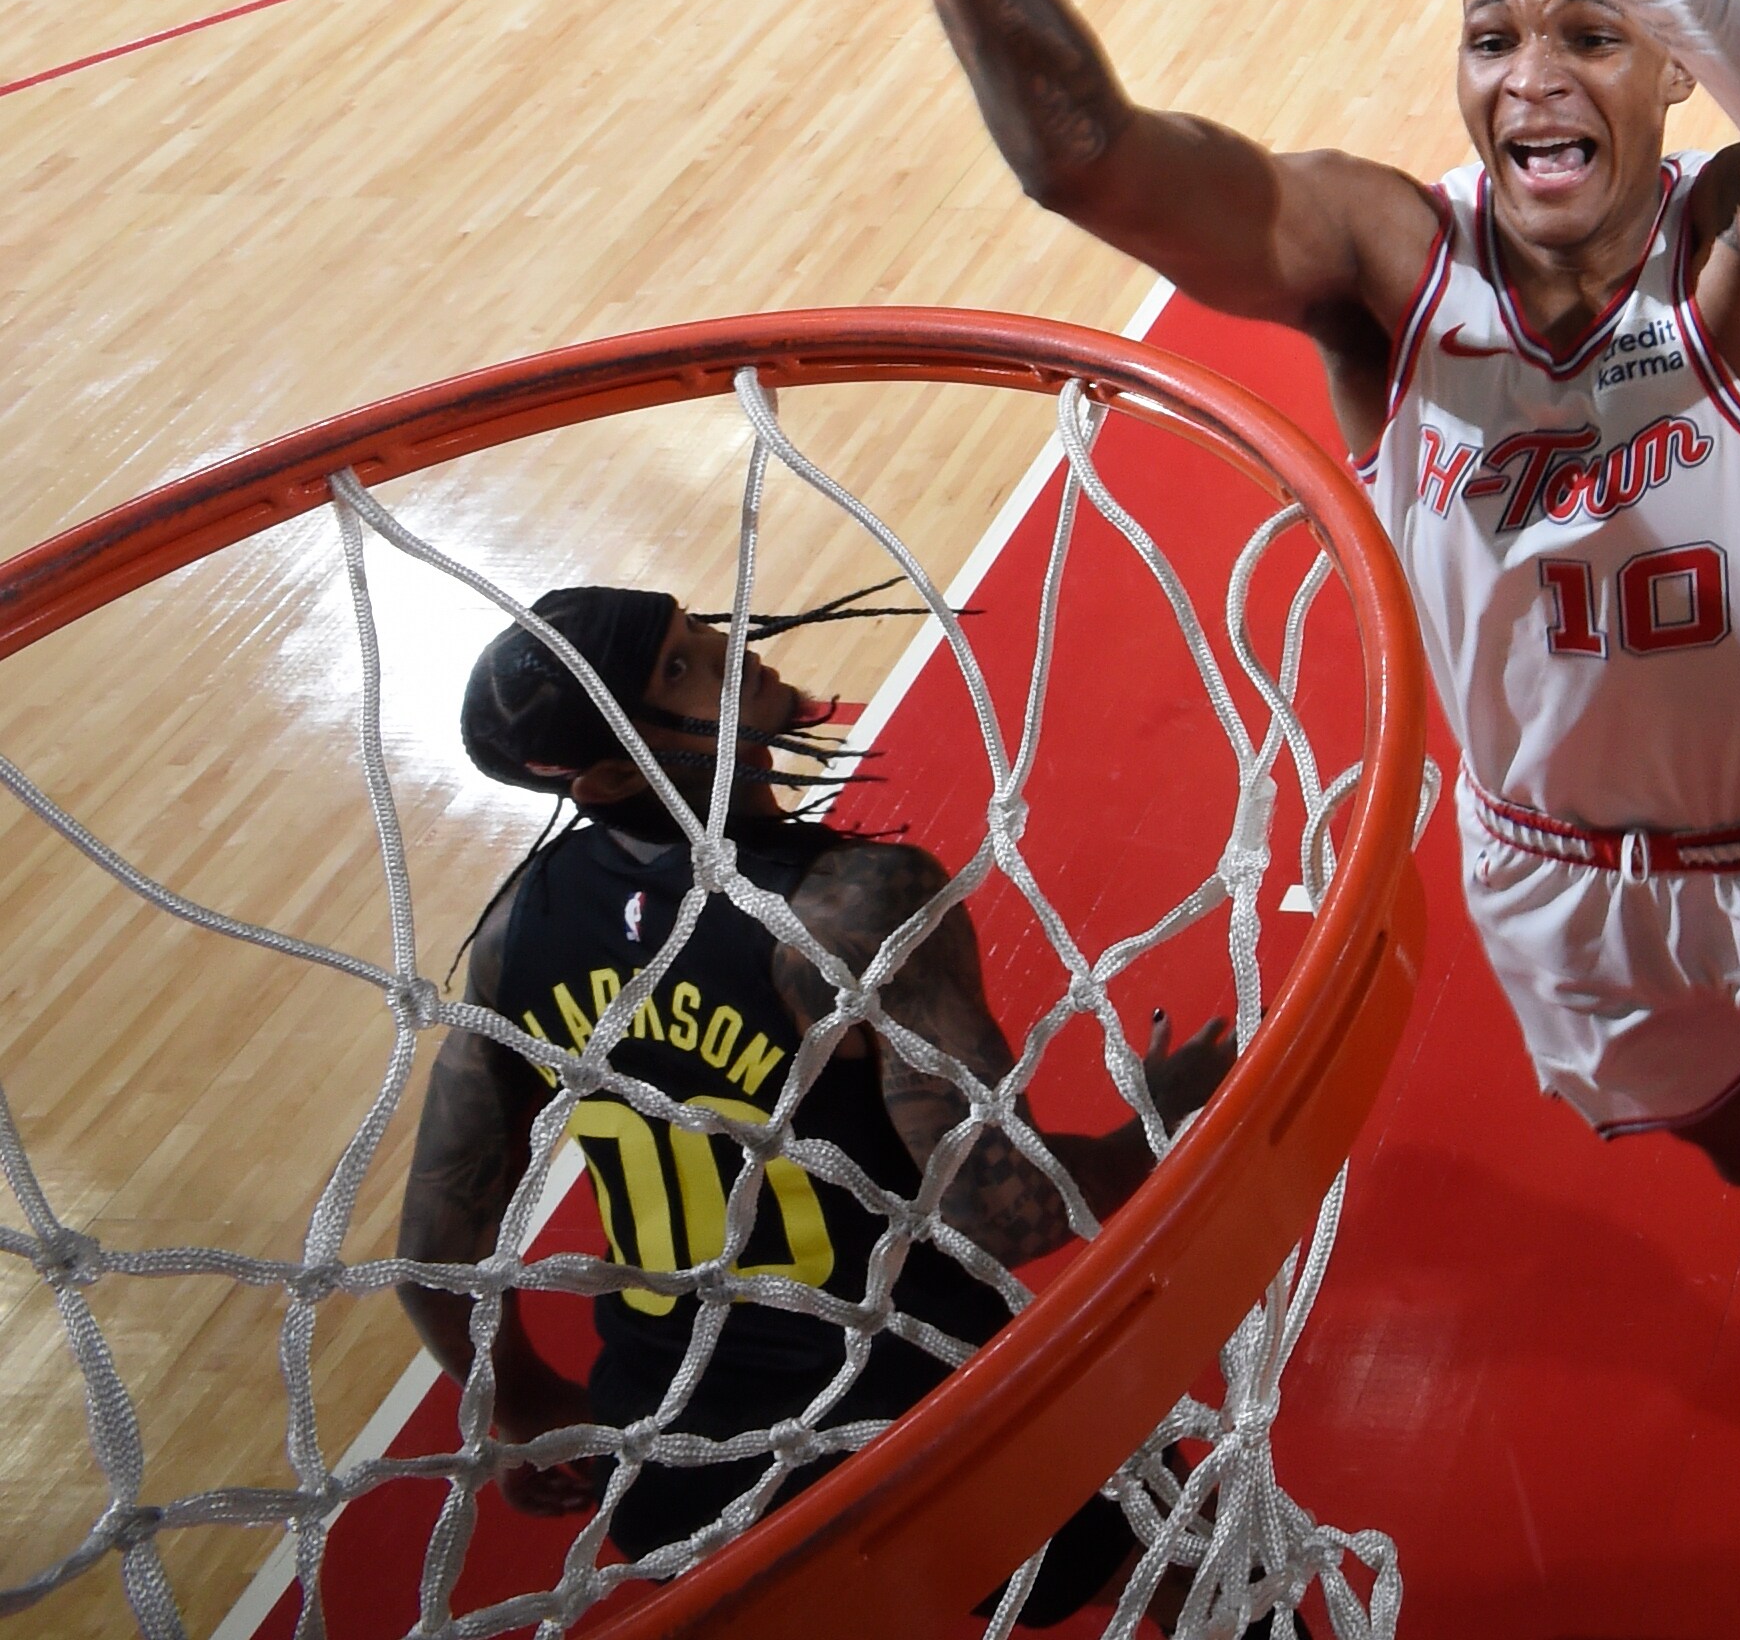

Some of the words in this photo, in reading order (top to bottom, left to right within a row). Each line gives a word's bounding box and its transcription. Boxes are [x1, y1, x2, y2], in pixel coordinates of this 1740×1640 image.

[1597, 350, 1685, 390] karma
[1417, 415, 1714, 533] H-Town
[1539, 540, 1732, 660] 10
[565, 1094, 836, 1316] 00
